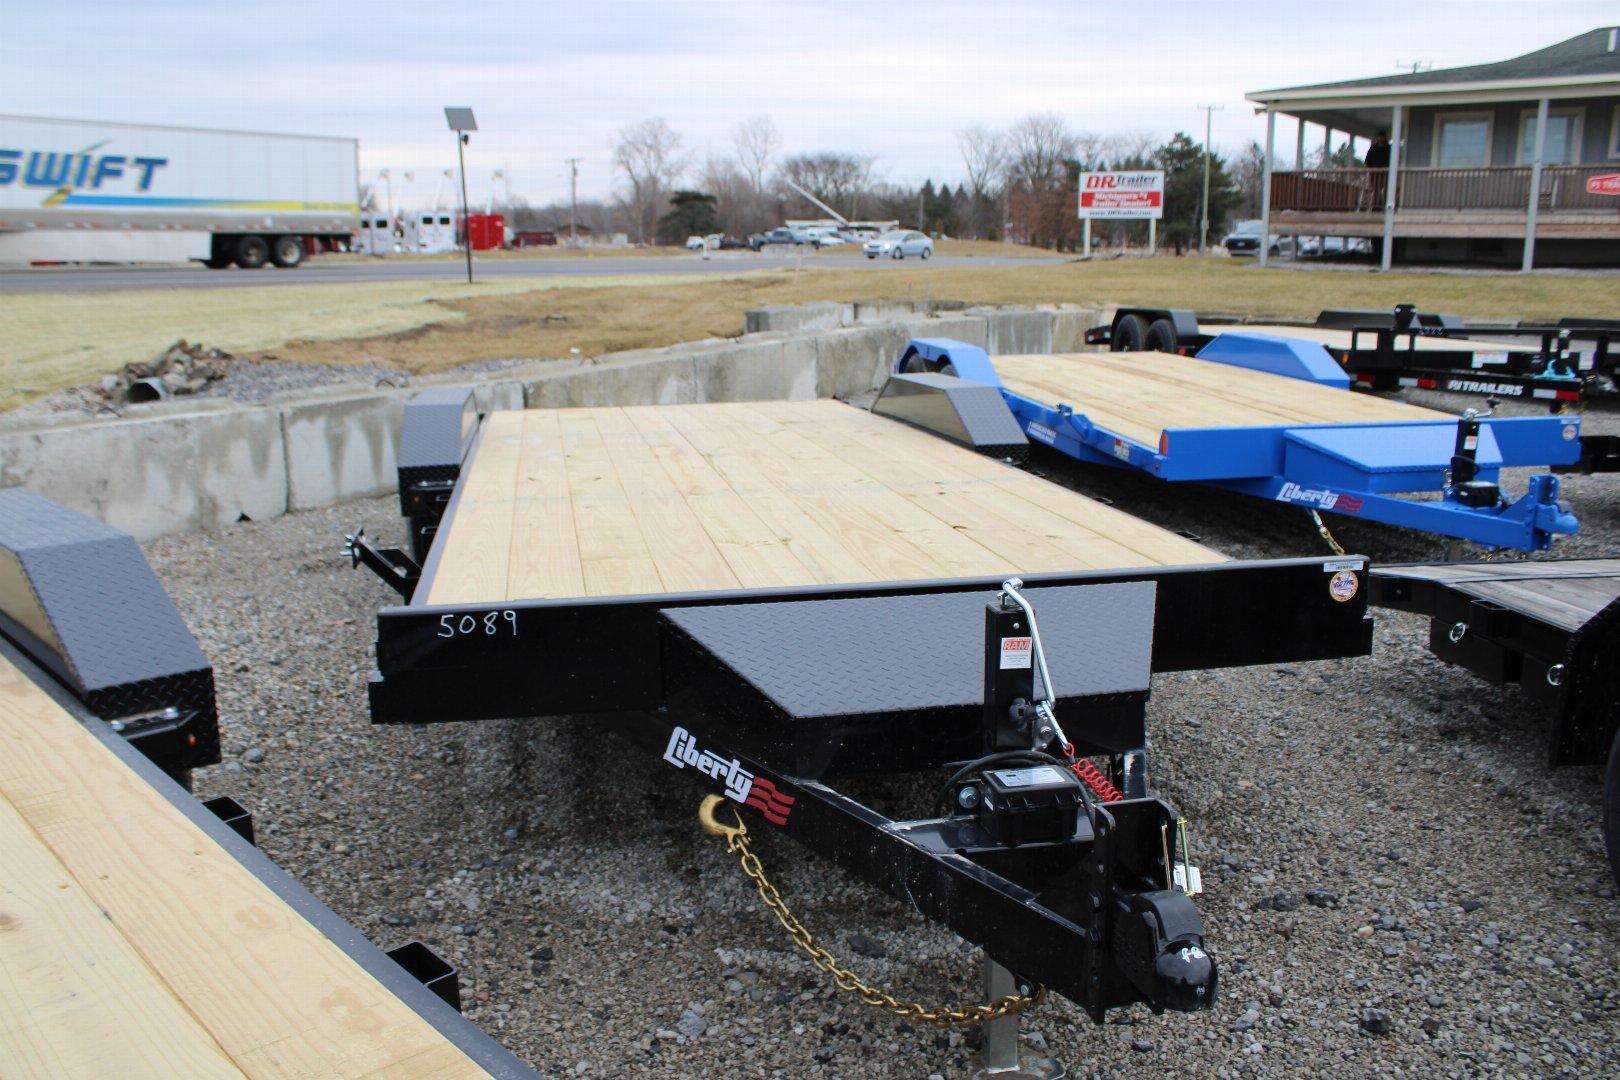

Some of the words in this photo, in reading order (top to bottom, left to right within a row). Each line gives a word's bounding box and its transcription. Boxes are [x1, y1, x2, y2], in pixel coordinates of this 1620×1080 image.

[0, 149, 168, 191] SWIFT
[1463, 381, 1523, 396] TRAILERS
[1275, 482, 1340, 509] Liberty
[437, 610, 517, 637] 5089
[1003, 640, 1030, 651] RAM
[662, 726, 754, 804] Liberty
